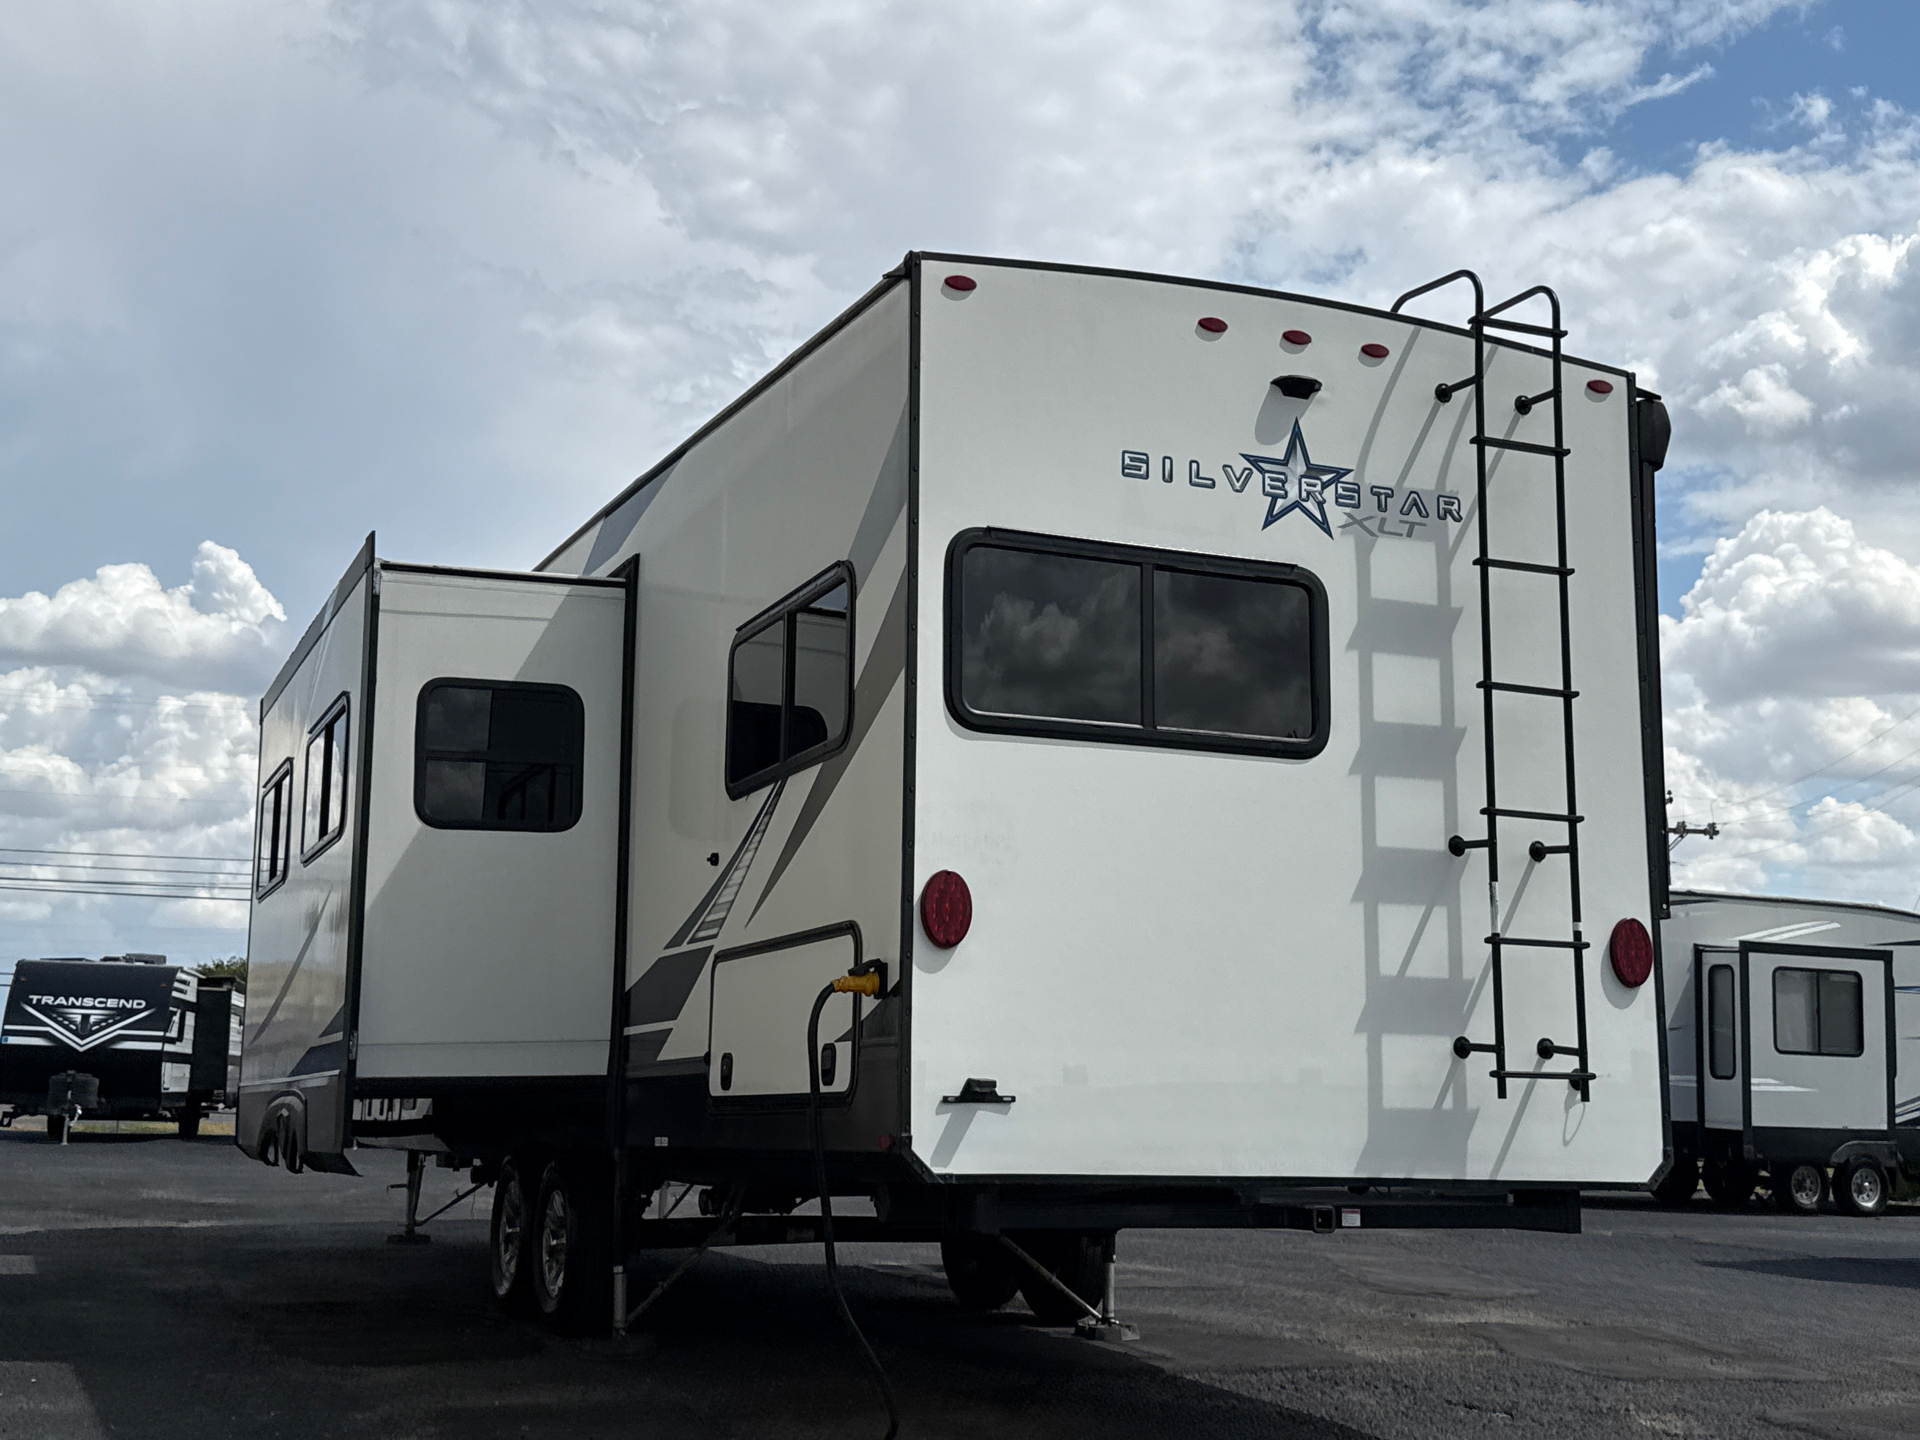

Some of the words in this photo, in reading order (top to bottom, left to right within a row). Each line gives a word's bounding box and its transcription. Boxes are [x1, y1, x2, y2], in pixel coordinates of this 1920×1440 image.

[1121, 450, 1463, 522] SILVERSTAR
[1337, 511, 1427, 538] XLT
[28, 994, 147, 1009] TRANSCEND
